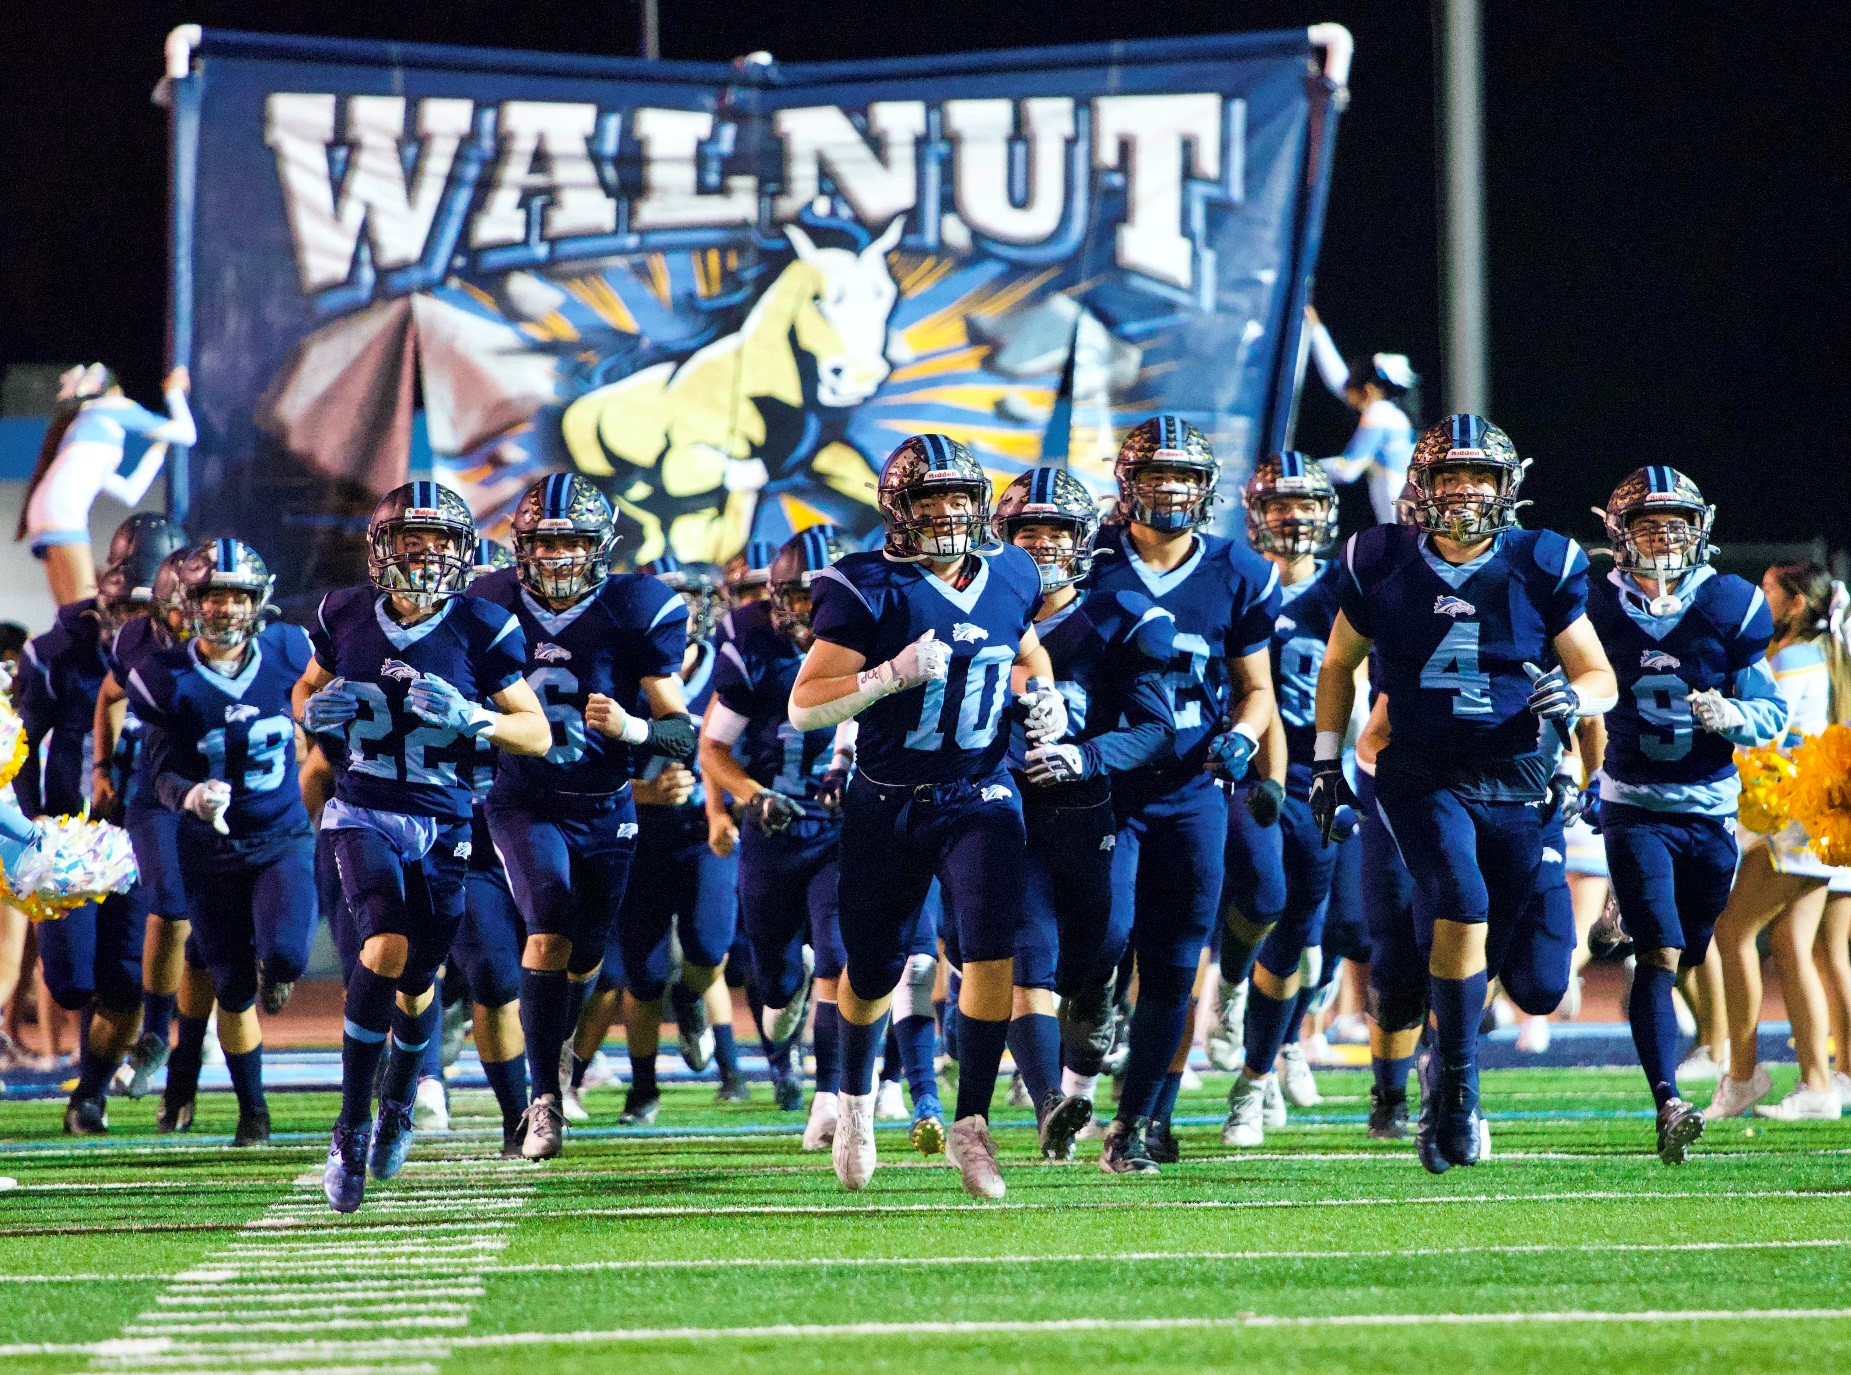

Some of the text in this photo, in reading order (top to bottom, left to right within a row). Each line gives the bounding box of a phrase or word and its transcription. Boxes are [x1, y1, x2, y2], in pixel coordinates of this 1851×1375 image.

[265, 92, 1223, 293] WALNUT
[526, 667, 587, 765] 6
[903, 645, 1015, 750] 10
[1420, 622, 1493, 715] 4
[1631, 674, 1693, 761] 9
[346, 681, 457, 787] 22
